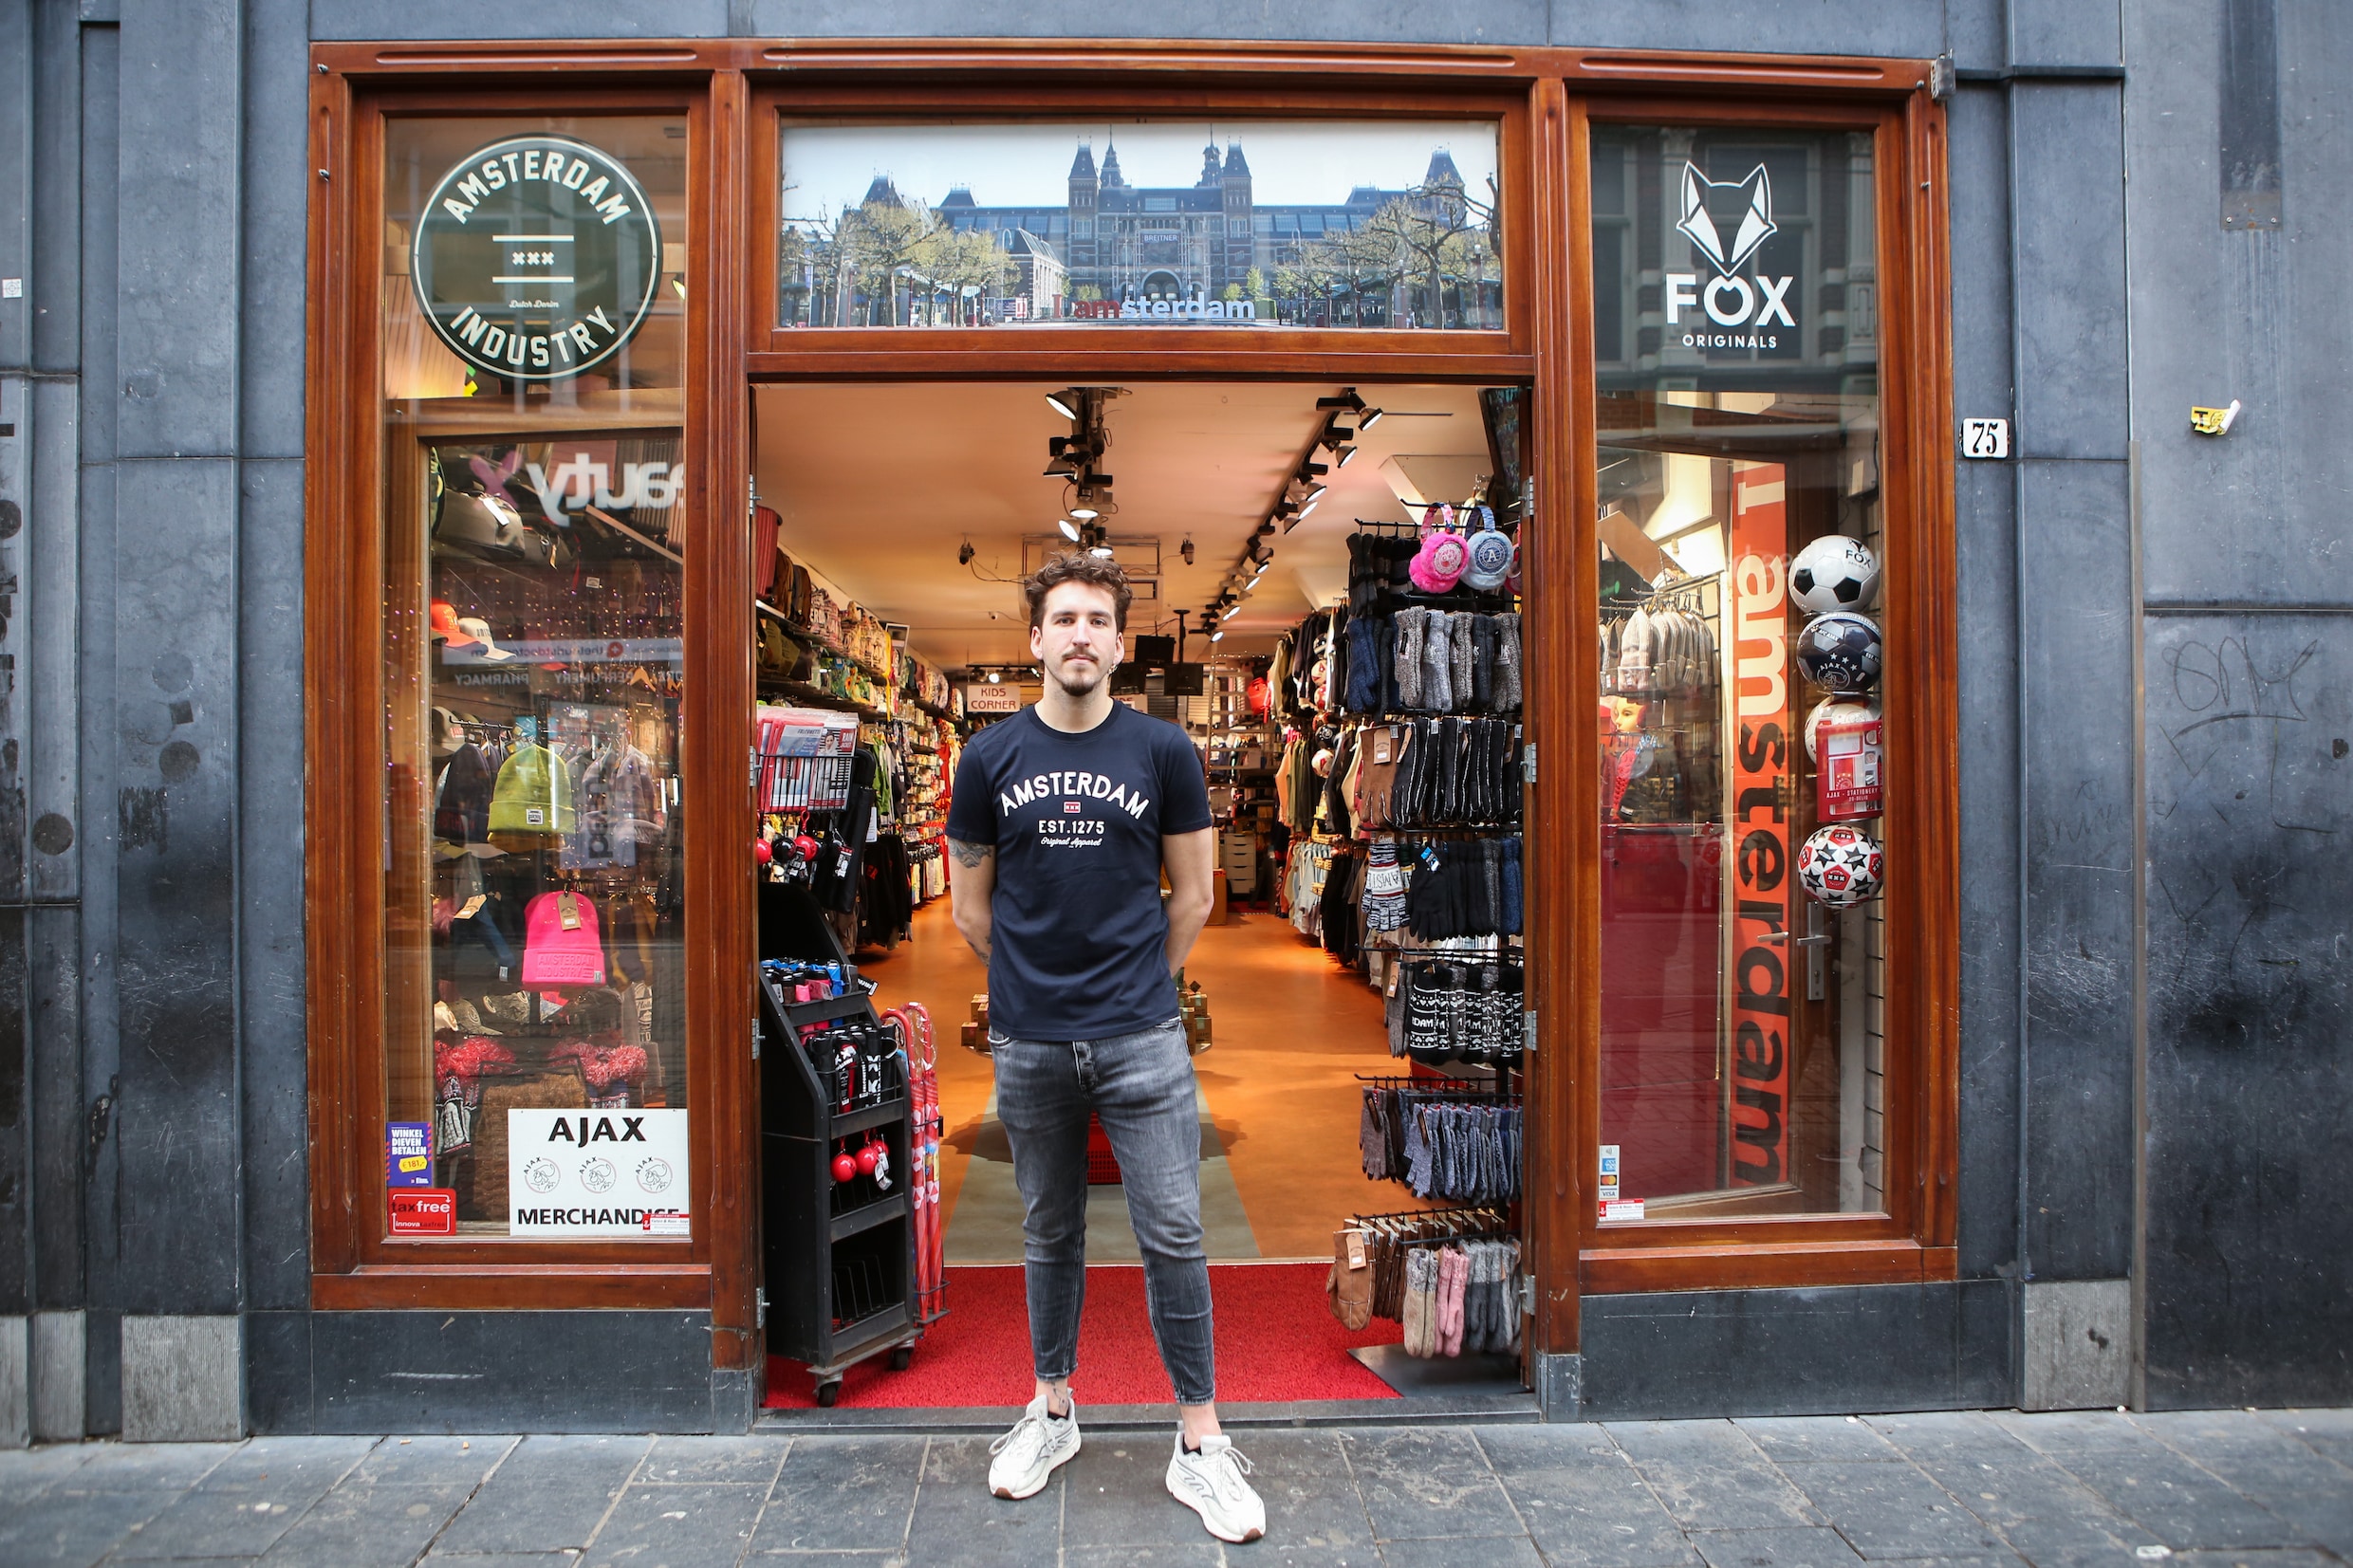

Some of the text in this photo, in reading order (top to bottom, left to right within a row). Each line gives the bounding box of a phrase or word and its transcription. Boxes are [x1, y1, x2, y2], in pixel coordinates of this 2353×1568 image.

[443, 150, 631, 225] AMSTERDAM
[510, 299, 560, 308] Dutch Denim
[1074, 291, 1255, 319] amsterdam
[1666, 273, 1796, 326] FOX
[450, 304, 616, 367] INDUSTRY
[1682, 334, 1777, 348] ORIGINALS
[1973, 423, 1998, 454] 75
[1845, 548, 1871, 569] FOX
[1820, 662, 1841, 672] AJAX
[981, 688, 1006, 697] KIDS
[971, 700, 1016, 710] CORNER
[1000, 771, 1150, 820] AMSTERDAM
[1846, 788, 1878, 797] STATIONERY
[1038, 820, 1105, 835] EST.1275
[1041, 837, 1102, 848] Original Apparel
[1734, 555, 1789, 1186] amsterdam
[537, 954, 595, 967] AMSTERDAM
[391, 1129, 424, 1138] WINKEL
[548, 1116, 647, 1148] AJAX
[391, 1137, 422, 1147] DIEVEN
[391, 1146, 427, 1155] BETALEN
[524, 1156, 541, 1175] AJAX
[579, 1156, 598, 1175] AJAX
[635, 1156, 653, 1175] AJAX
[391, 1200, 451, 1213] taxfree
